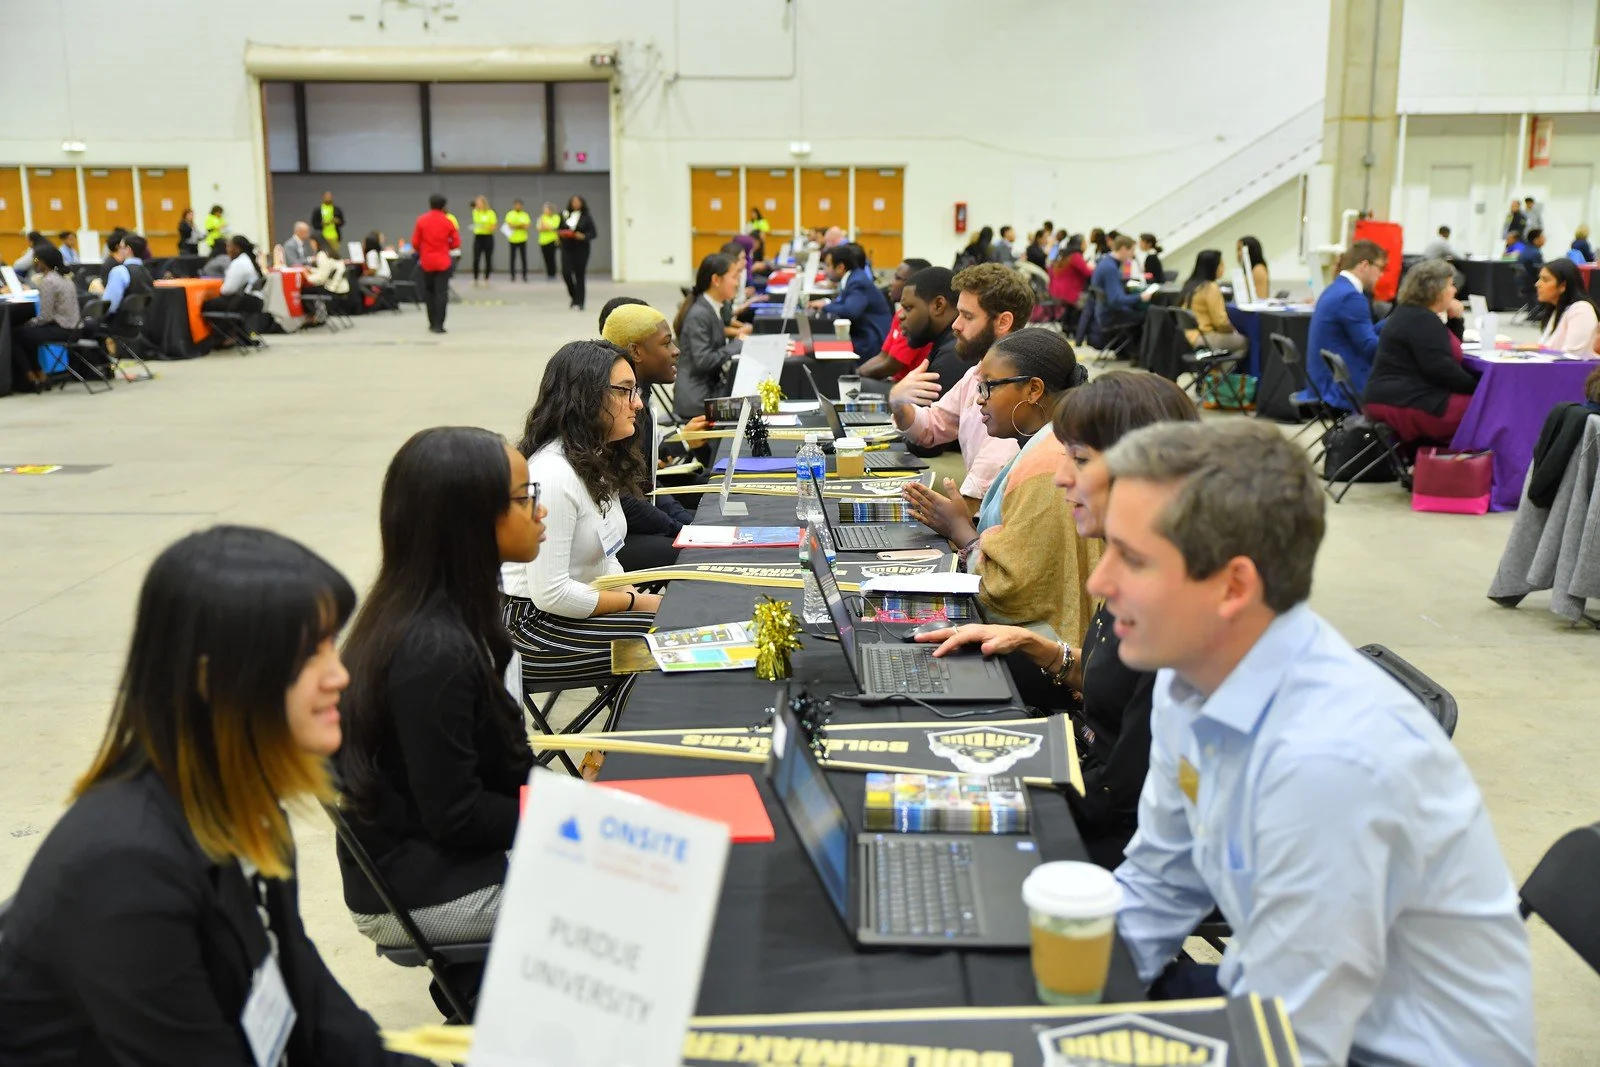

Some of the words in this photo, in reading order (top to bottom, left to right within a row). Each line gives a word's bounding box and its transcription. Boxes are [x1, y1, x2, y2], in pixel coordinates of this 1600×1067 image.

[939, 732, 1031, 748] PURDUE
[599, 816, 689, 861] ONSITE
[547, 914, 643, 973] PURDUE
[520, 953, 654, 1023] UNIVERSITY
[683, 1031, 1014, 1067] BOILERMAKER
[1060, 1029, 1208, 1066] PURDUE
